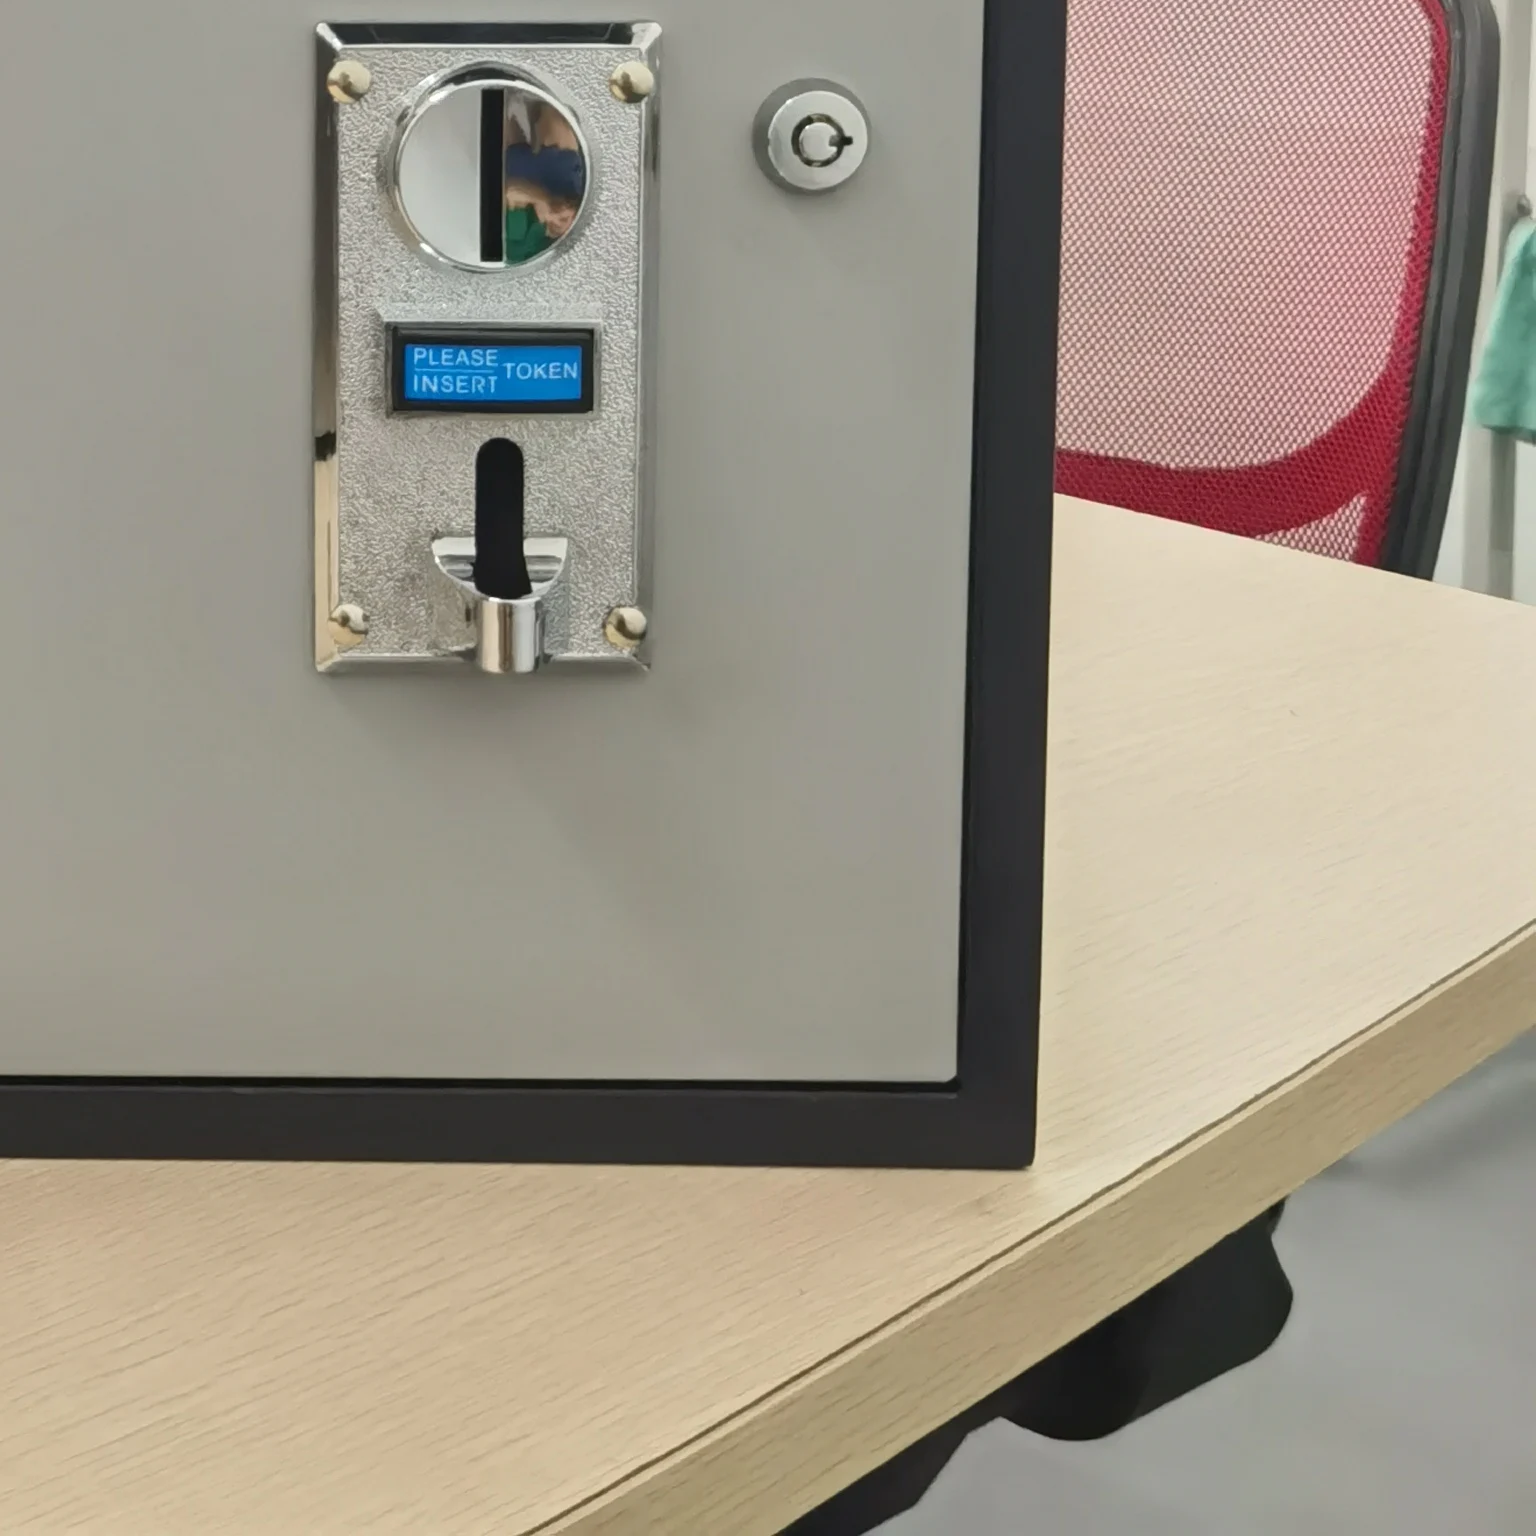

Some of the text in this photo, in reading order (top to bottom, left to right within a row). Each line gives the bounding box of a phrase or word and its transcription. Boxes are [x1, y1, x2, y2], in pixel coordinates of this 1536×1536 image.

[413, 347, 498, 366] PLEASE
[502, 362, 578, 380] TOKEN
[413, 375, 498, 394] INSERT
